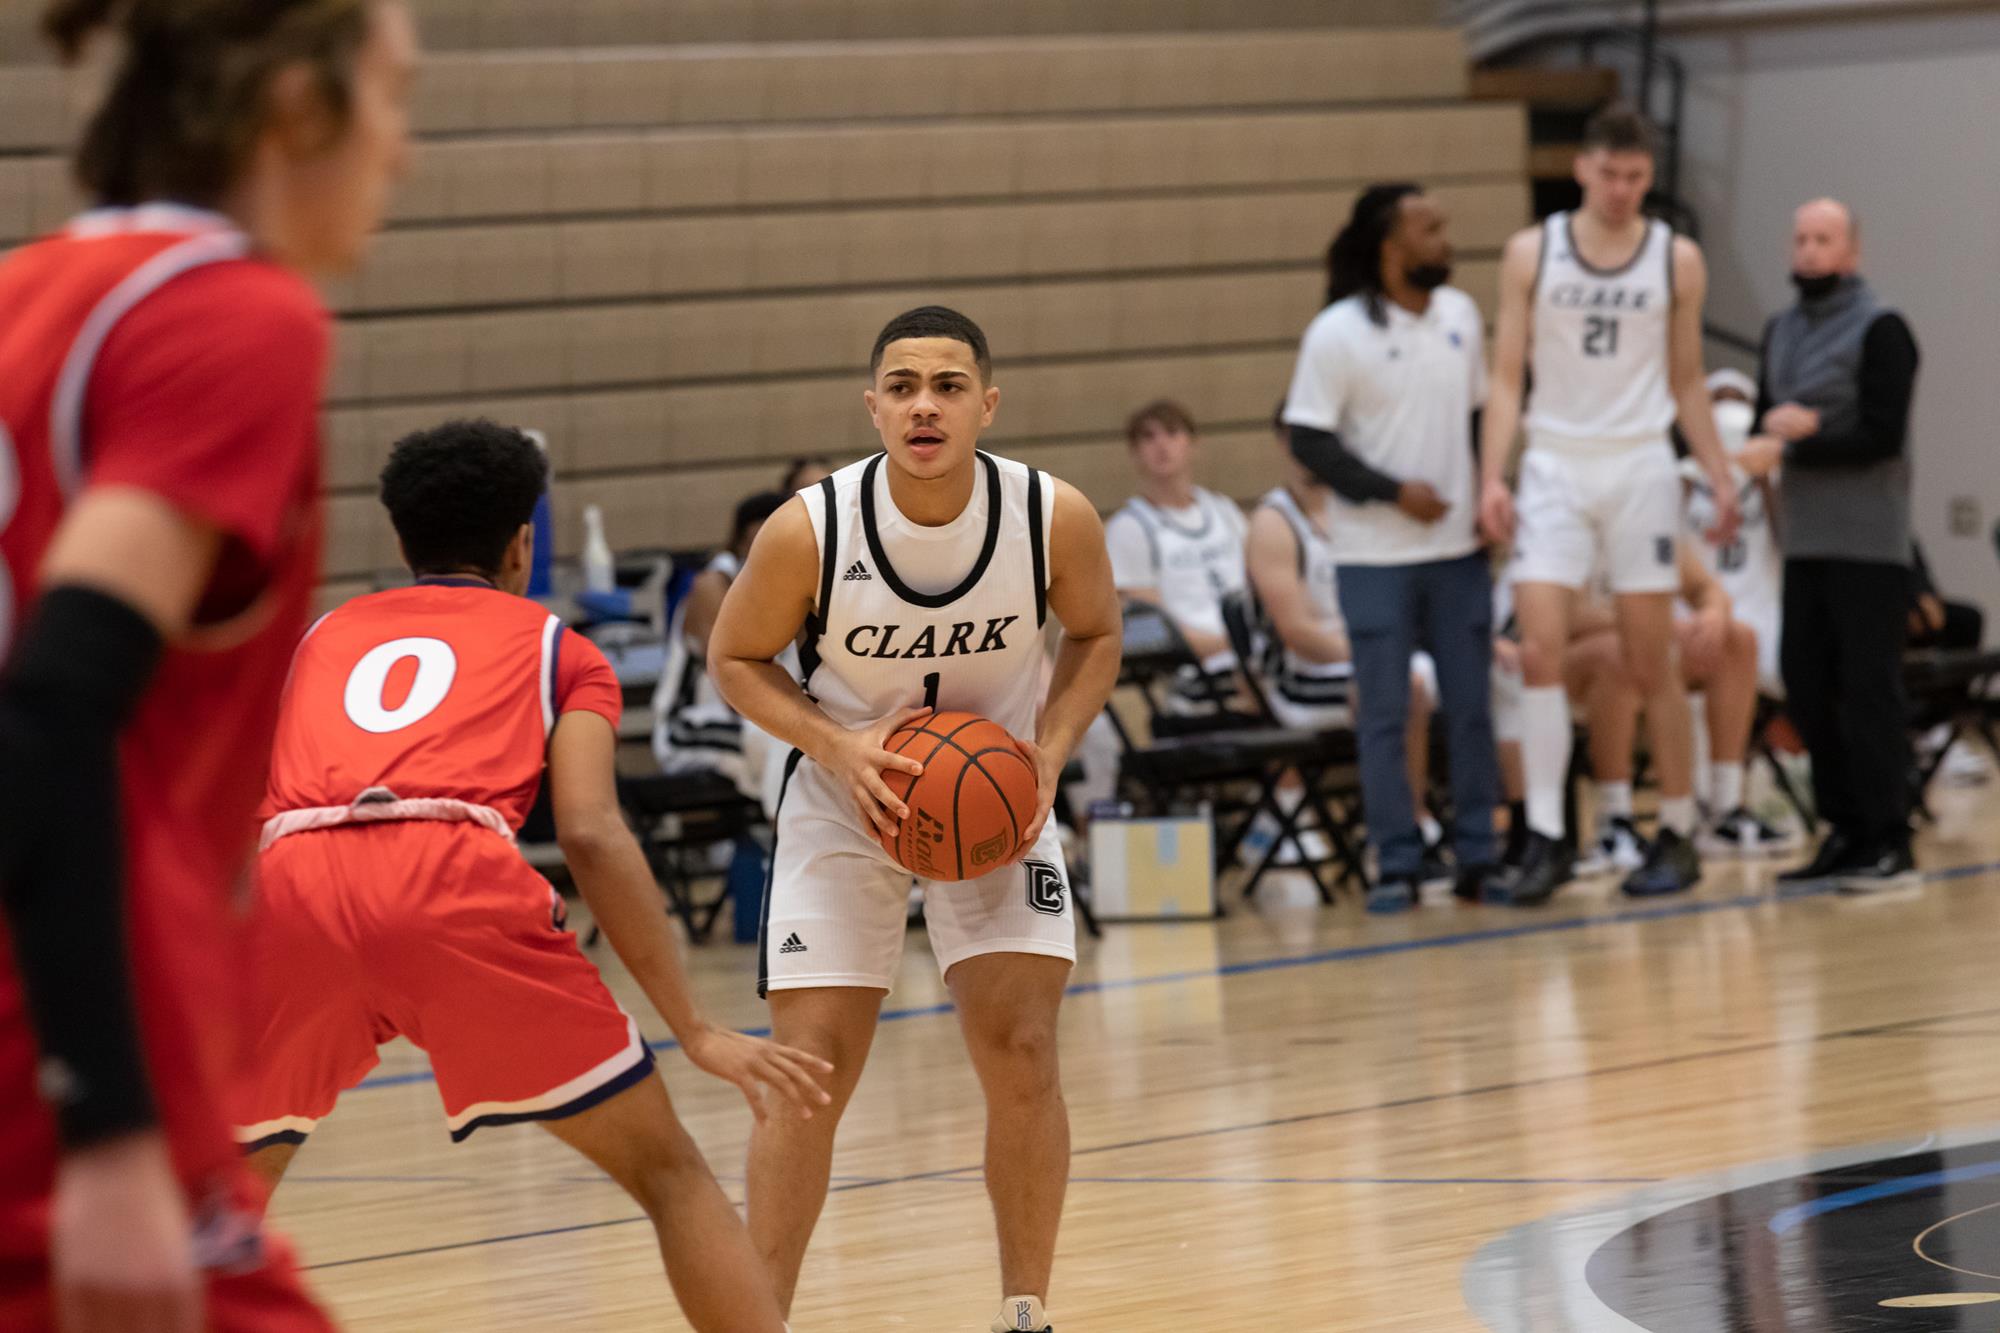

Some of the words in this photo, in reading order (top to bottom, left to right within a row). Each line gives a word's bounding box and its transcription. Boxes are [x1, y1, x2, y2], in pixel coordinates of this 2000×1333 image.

[1583, 316, 1618, 356] 21
[843, 572, 872, 581] adidas
[845, 615, 1019, 660] CLARK
[344, 636, 457, 733] 0
[923, 672, 940, 713] 1
